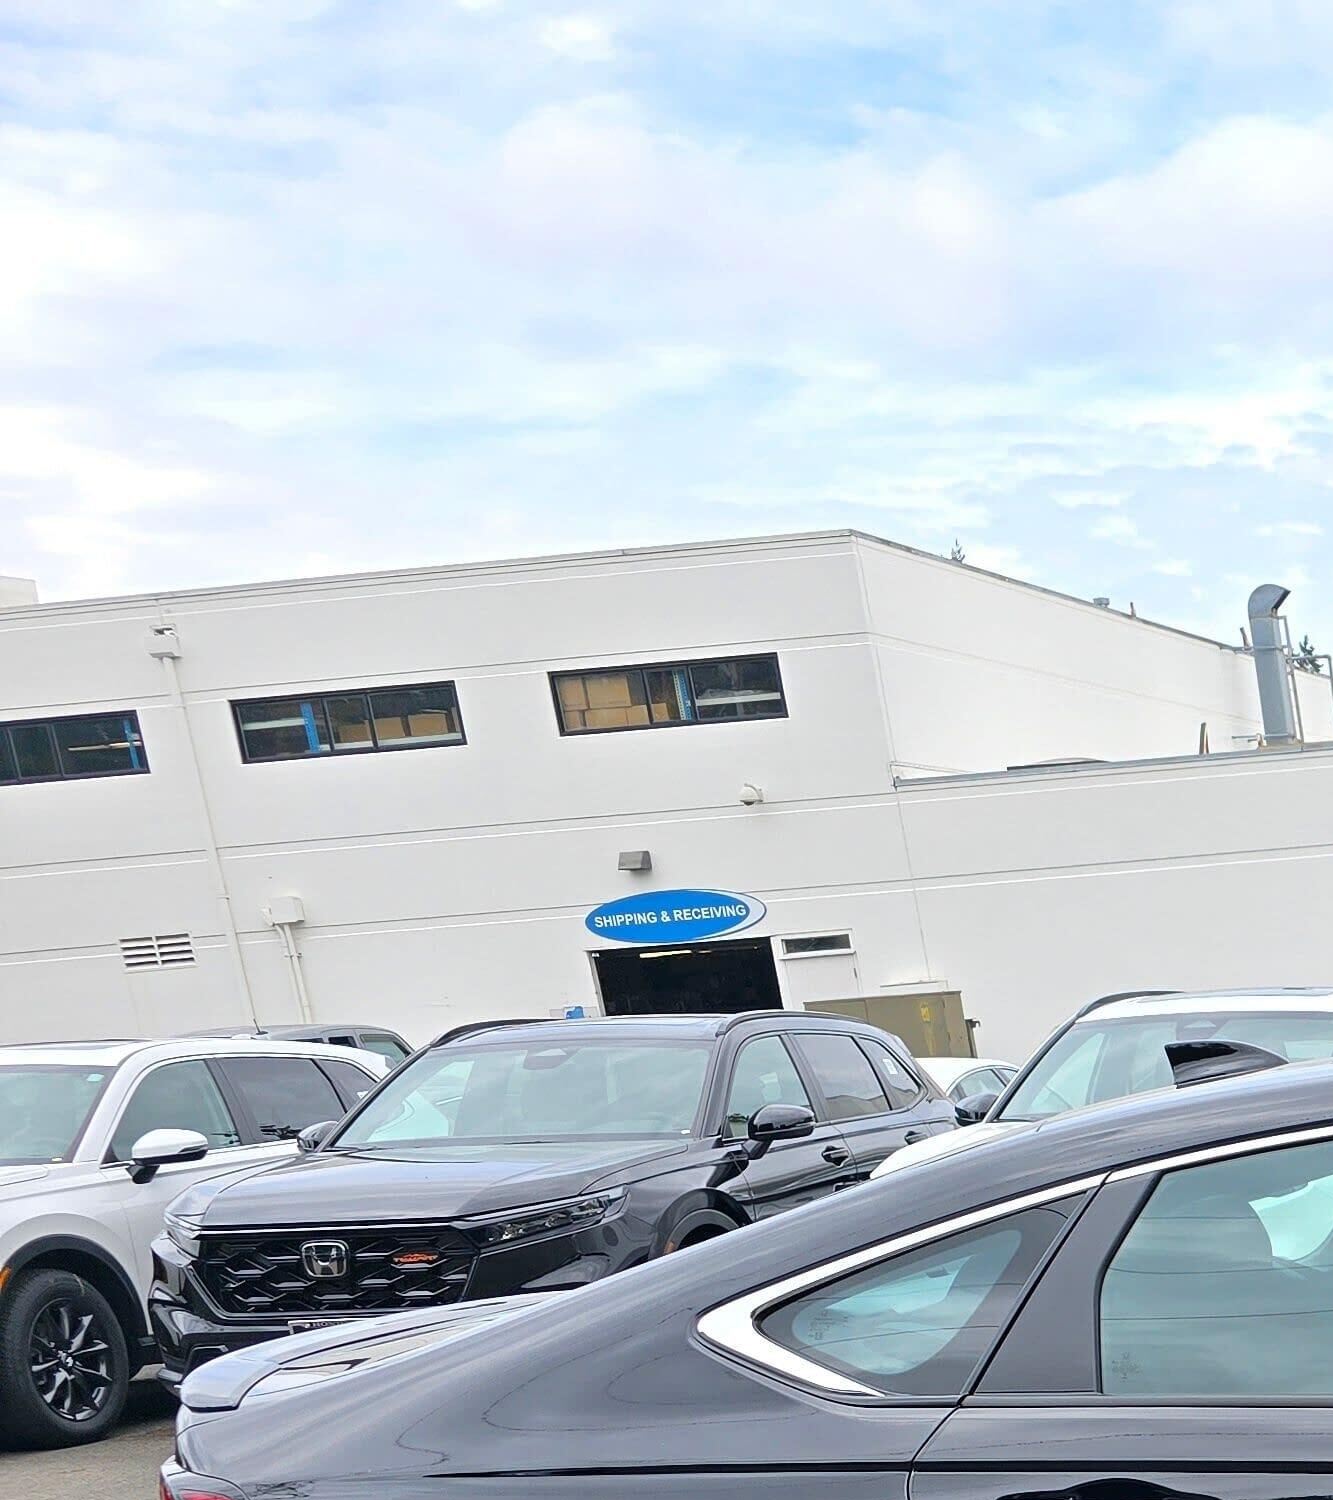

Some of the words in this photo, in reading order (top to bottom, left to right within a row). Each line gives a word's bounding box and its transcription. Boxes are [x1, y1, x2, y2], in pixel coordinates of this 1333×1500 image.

[594, 912, 657, 928] SHIPPING
[660, 910, 672, 922] &
[674, 904, 747, 921] RECEIVING
